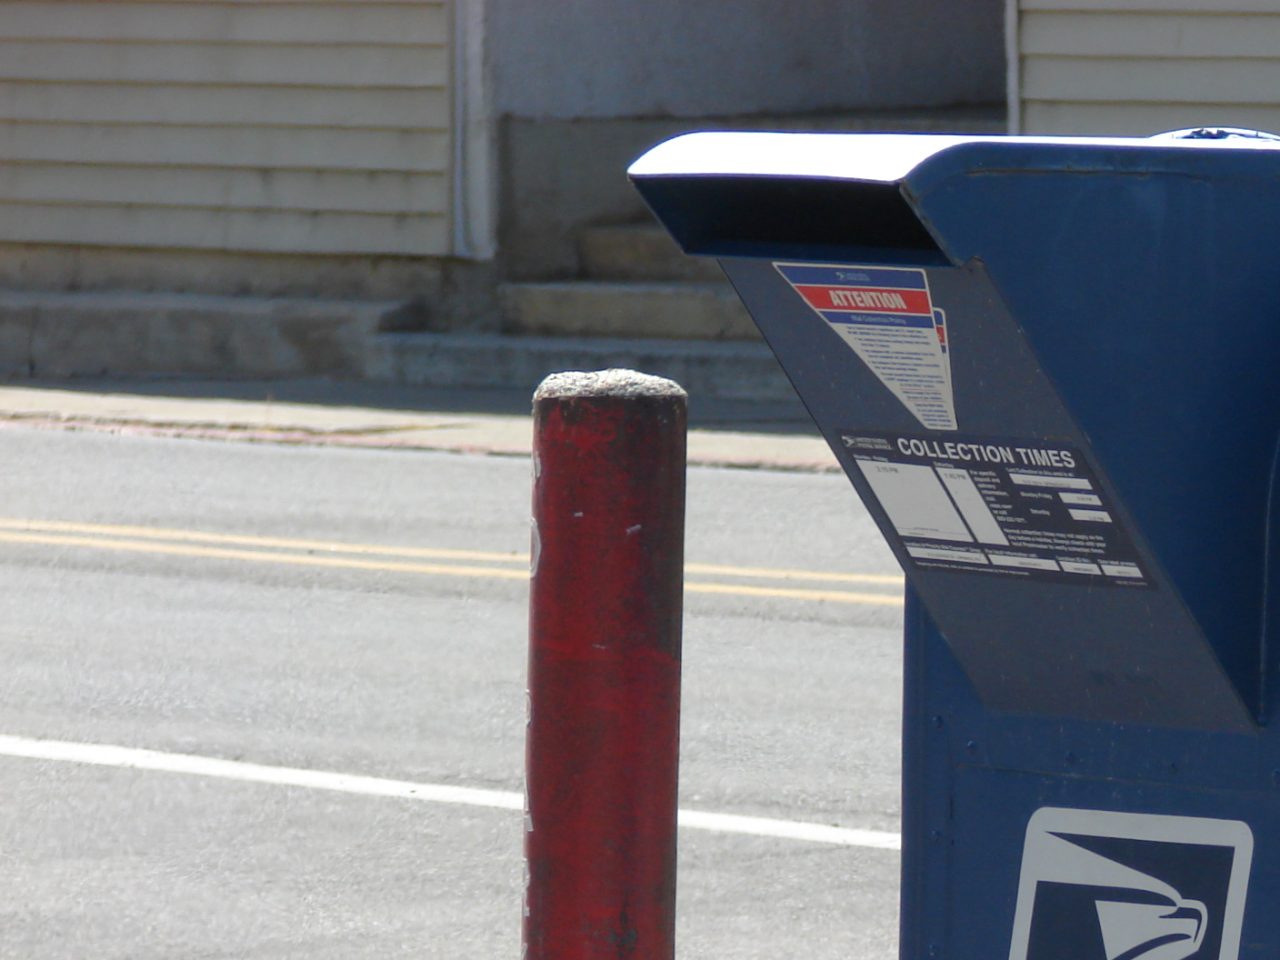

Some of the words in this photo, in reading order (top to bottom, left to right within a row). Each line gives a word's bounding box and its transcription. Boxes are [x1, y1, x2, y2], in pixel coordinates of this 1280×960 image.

[828, 290, 907, 309] ATTENTION
[897, 438, 1015, 464] COLLECTION
[1015, 447, 1076, 469] TIMES
